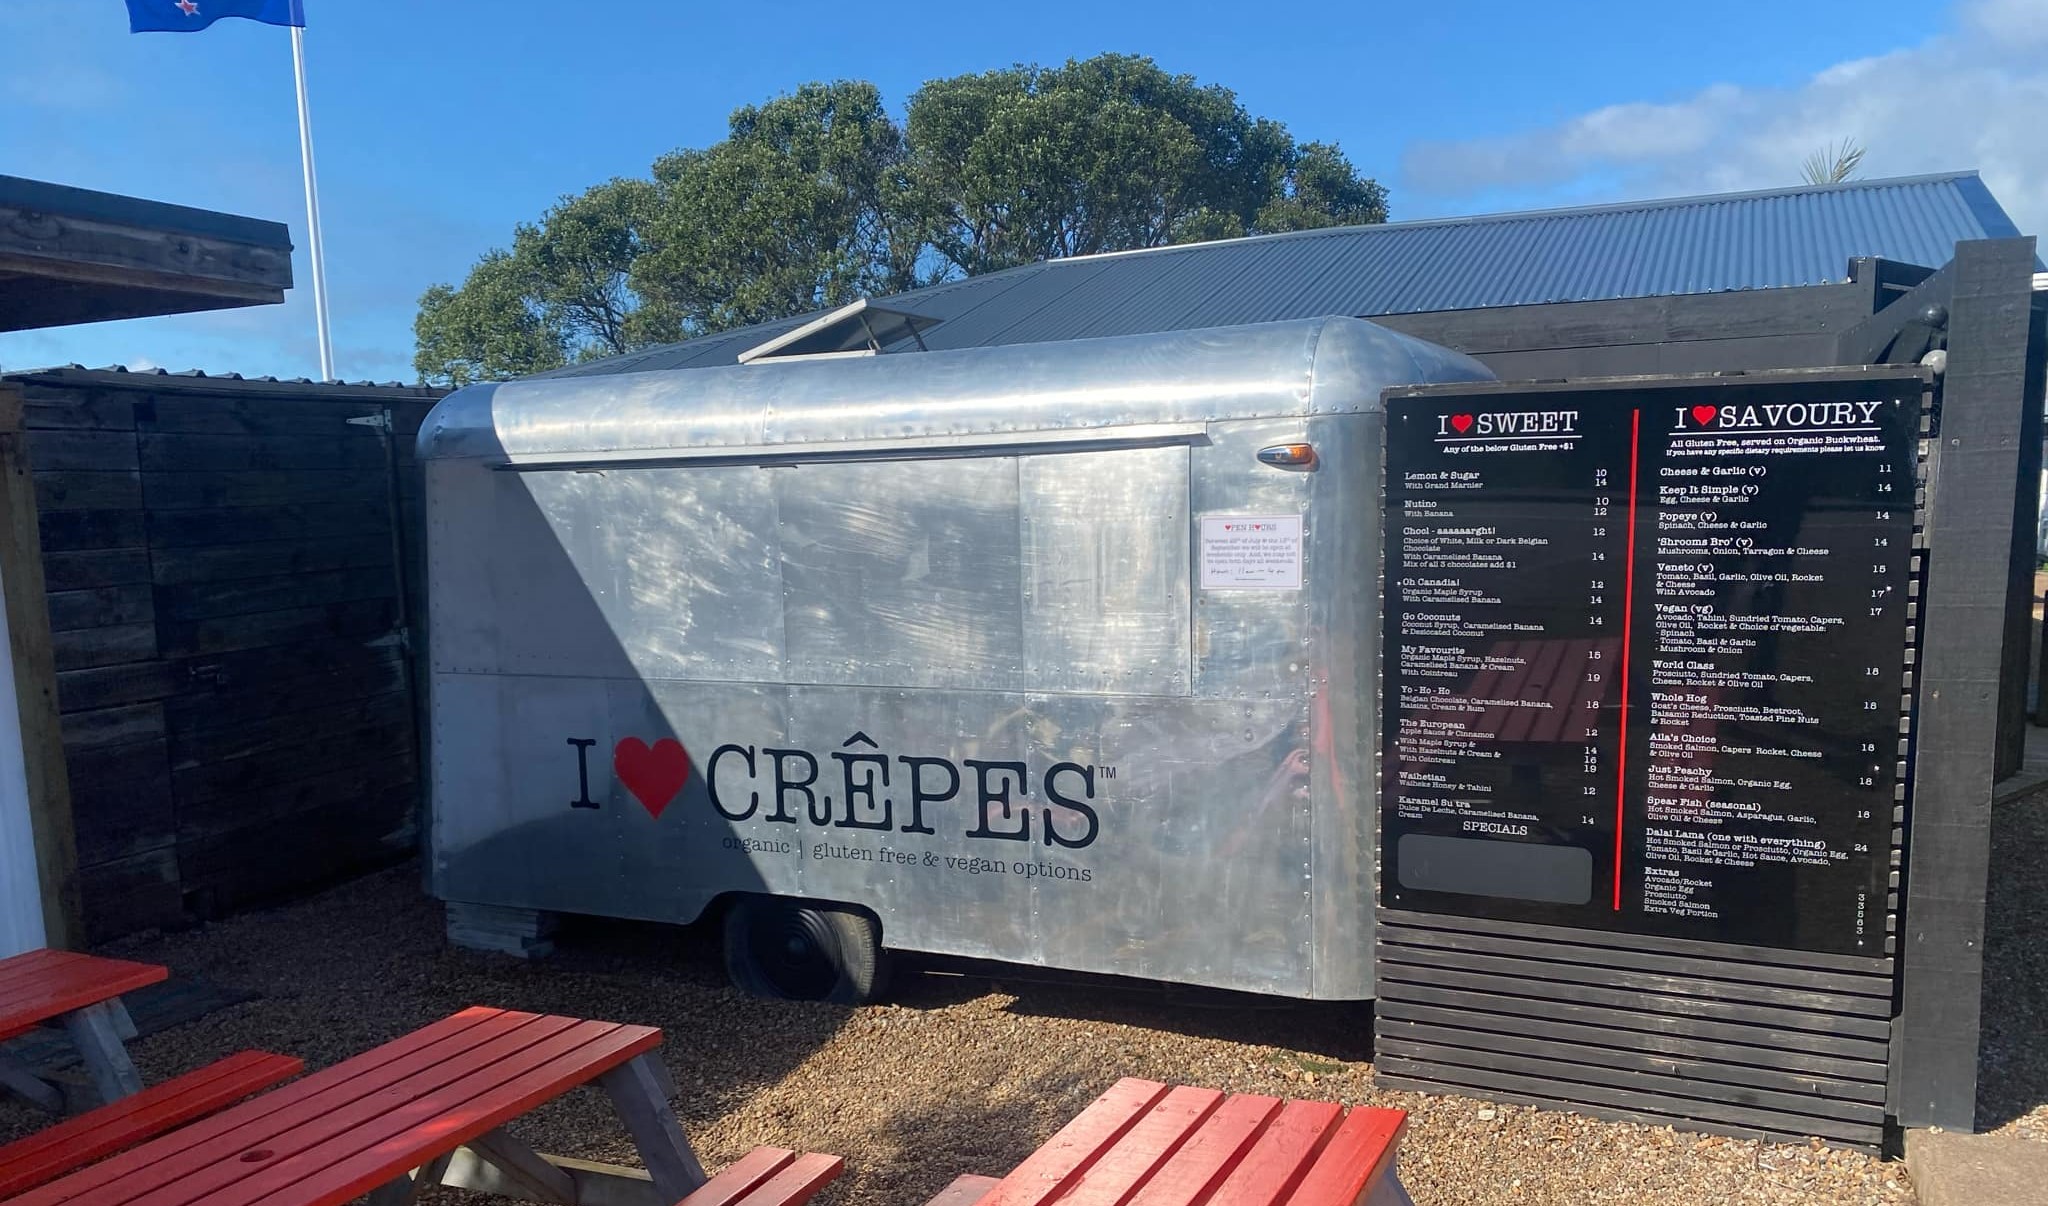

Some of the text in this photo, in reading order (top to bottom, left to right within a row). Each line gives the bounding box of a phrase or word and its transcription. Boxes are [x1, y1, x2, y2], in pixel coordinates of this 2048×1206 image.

[1674, 401, 1882, 429] I SAVOURY
[1437, 410, 1578, 435] I SWEET
[1671, 440, 1683, 448] All
[1685, 439, 1714, 448] Gluten
[1741, 438, 1771, 446] served
[1787, 437, 1823, 447] Organic
[1443, 446, 1459, 455] Any
[1485, 444, 1508, 452] below
[1596, 469, 1607, 477] 10
[1660, 466, 1766, 476] Cheese & Garlic (v)
[1879, 465, 1891, 473] 11
[1404, 472, 1437, 480] Lemon
[1450, 471, 1480, 481] Sugar
[1595, 478, 1607, 486] 14
[1659, 485, 1759, 497] Keep It Simple (v)
[1877, 484, 1891, 492] 14
[1404, 500, 1437, 508] Nutino
[1594, 508, 1607, 516] 12
[1876, 512, 1889, 520] 14
[1658, 512, 1717, 524] Popeye (v)
[1593, 528, 1605, 536] 12
[1735, 538, 1753, 548] (v)
[1874, 538, 1888, 546] 14
[1592, 553, 1604, 561] 14
[1657, 563, 1714, 574] Veneto (v)
[1872, 565, 1886, 573] 15
[1402, 578, 1415, 586] Oh
[1591, 581, 1604, 589] 12
[1656, 588, 1715, 596] With Avocado
[1871, 590, 1884, 598] 17
[1590, 596, 1602, 604] 14
[1654, 604, 1714, 616] Vegan (vg)
[1869, 608, 1882, 616] 17
[1416, 613, 1461, 621] Coconuts
[1589, 617, 1602, 625] 14
[1401, 645, 1465, 655] My Favourite
[1588, 651, 1601, 659] 15
[1652, 661, 1714, 670] World Class
[1865, 668, 1879, 676] 18
[1587, 674, 1600, 682] 19
[1651, 693, 1707, 705] Whole Hog
[1585, 701, 1599, 709] 18
[1863, 701, 1877, 710] 18
[1399, 719, 1465, 731] The European
[1585, 729, 1598, 737] 12
[1681, 734, 1716, 744] Choice
[1583, 747, 1597, 755] 14
[1861, 744, 1874, 752] 18
[1583, 756, 1597, 764] 16
[1099, 766, 1116, 779] TM
[1583, 765, 1596, 773] 19
[1648, 765, 1712, 778] Just Peachy
[1859, 777, 1872, 786] 18
[567, 731, 1099, 849] I CRÊPES
[1583, 787, 1596, 795] 12
[1647, 796, 1761, 812] Spear Fish (seasonal)
[1857, 810, 1870, 818] 18
[1581, 816, 1595, 825] 14
[1463, 821, 1528, 836] SPECIALS
[1646, 828, 1672, 838] Dalai
[1707, 832, 1731, 844] (one
[1733, 834, 1757, 844] with
[1760, 835, 1826, 851] everything)
[1854, 844, 1868, 852] 24
[722, 837, 1092, 883] organic gluten free & vegan options
[1644, 867, 1680, 876] Extras
[1644, 876, 1712, 887] Avocado/Rocket
[1644, 898, 1710, 910] Smoked Salmon
